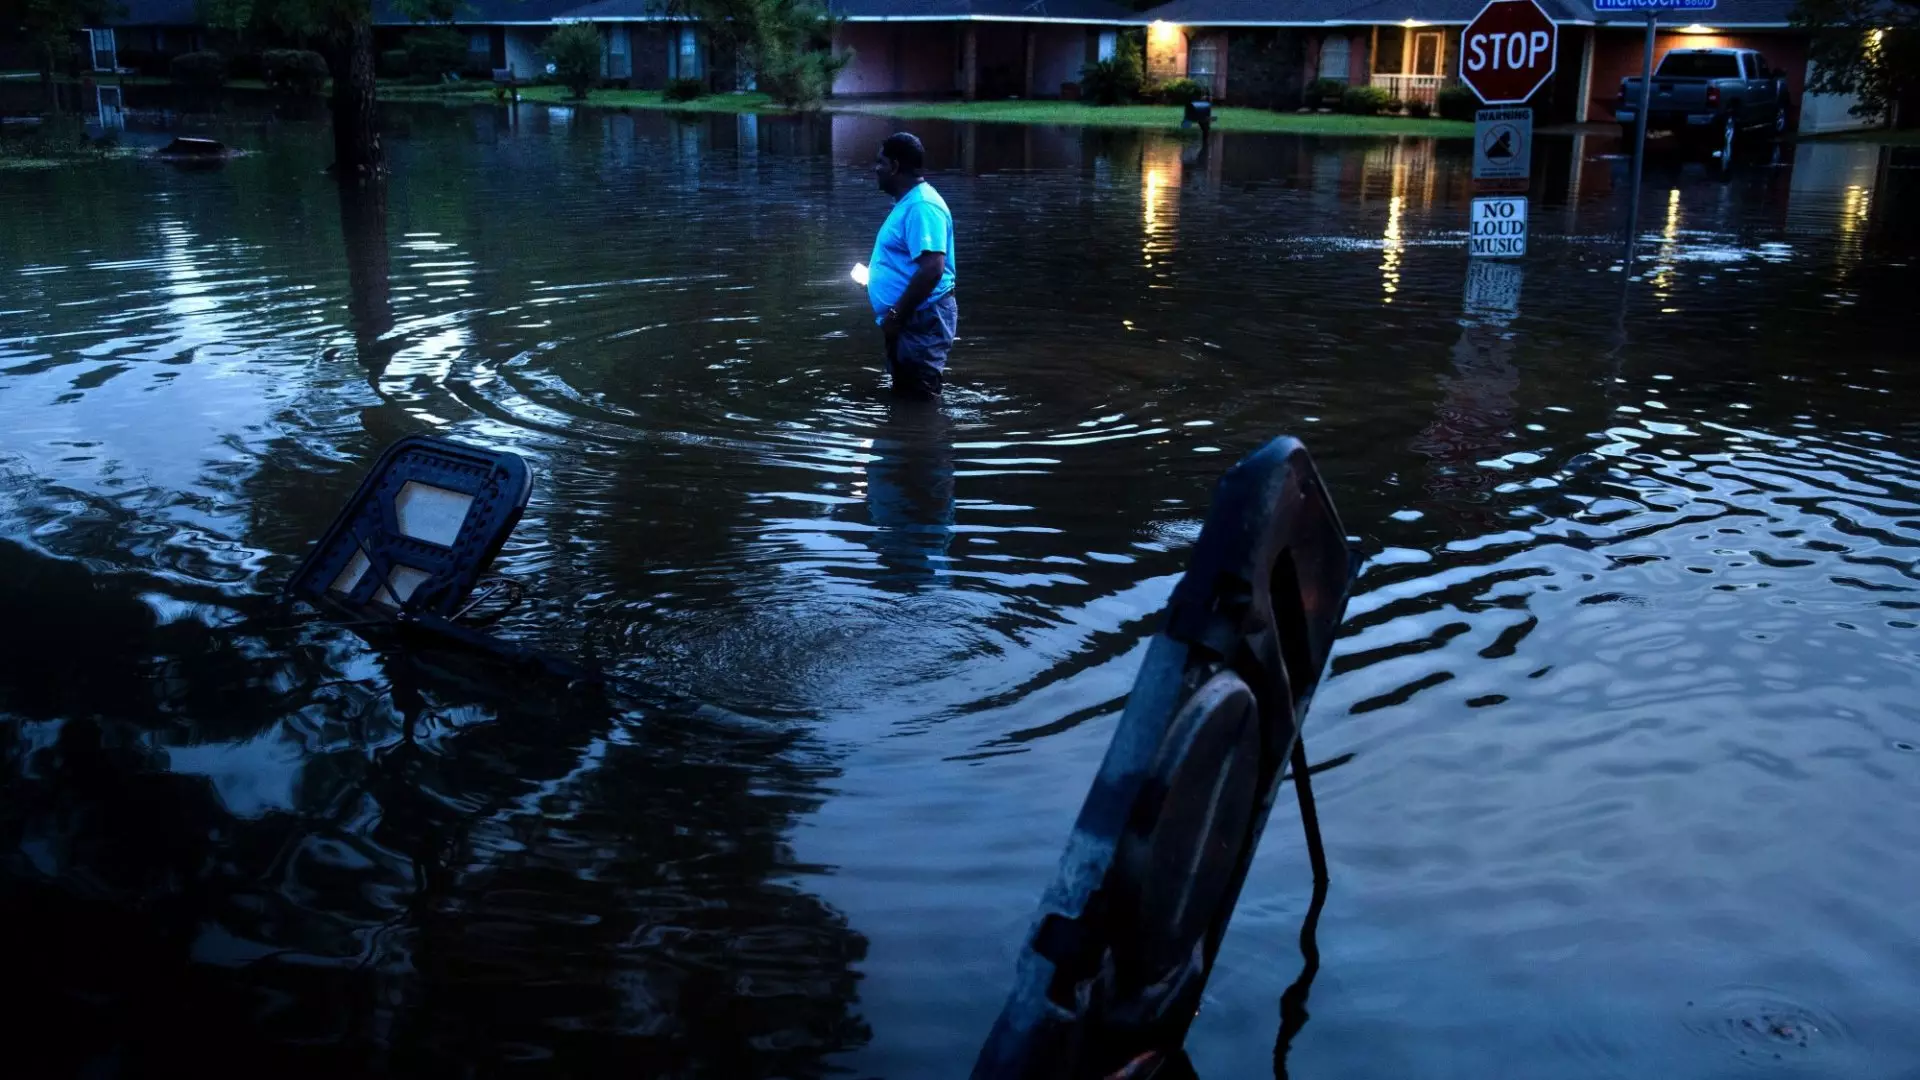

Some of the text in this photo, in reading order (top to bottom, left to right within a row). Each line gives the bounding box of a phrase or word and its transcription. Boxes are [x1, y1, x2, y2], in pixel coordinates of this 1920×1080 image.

[1467, 31, 1549, 71] STOP
[1478, 110, 1529, 121] WARNING
[1483, 202, 1514, 218] NO
[1472, 220, 1524, 236] LOUD
[1471, 238, 1523, 254] MUSIC
